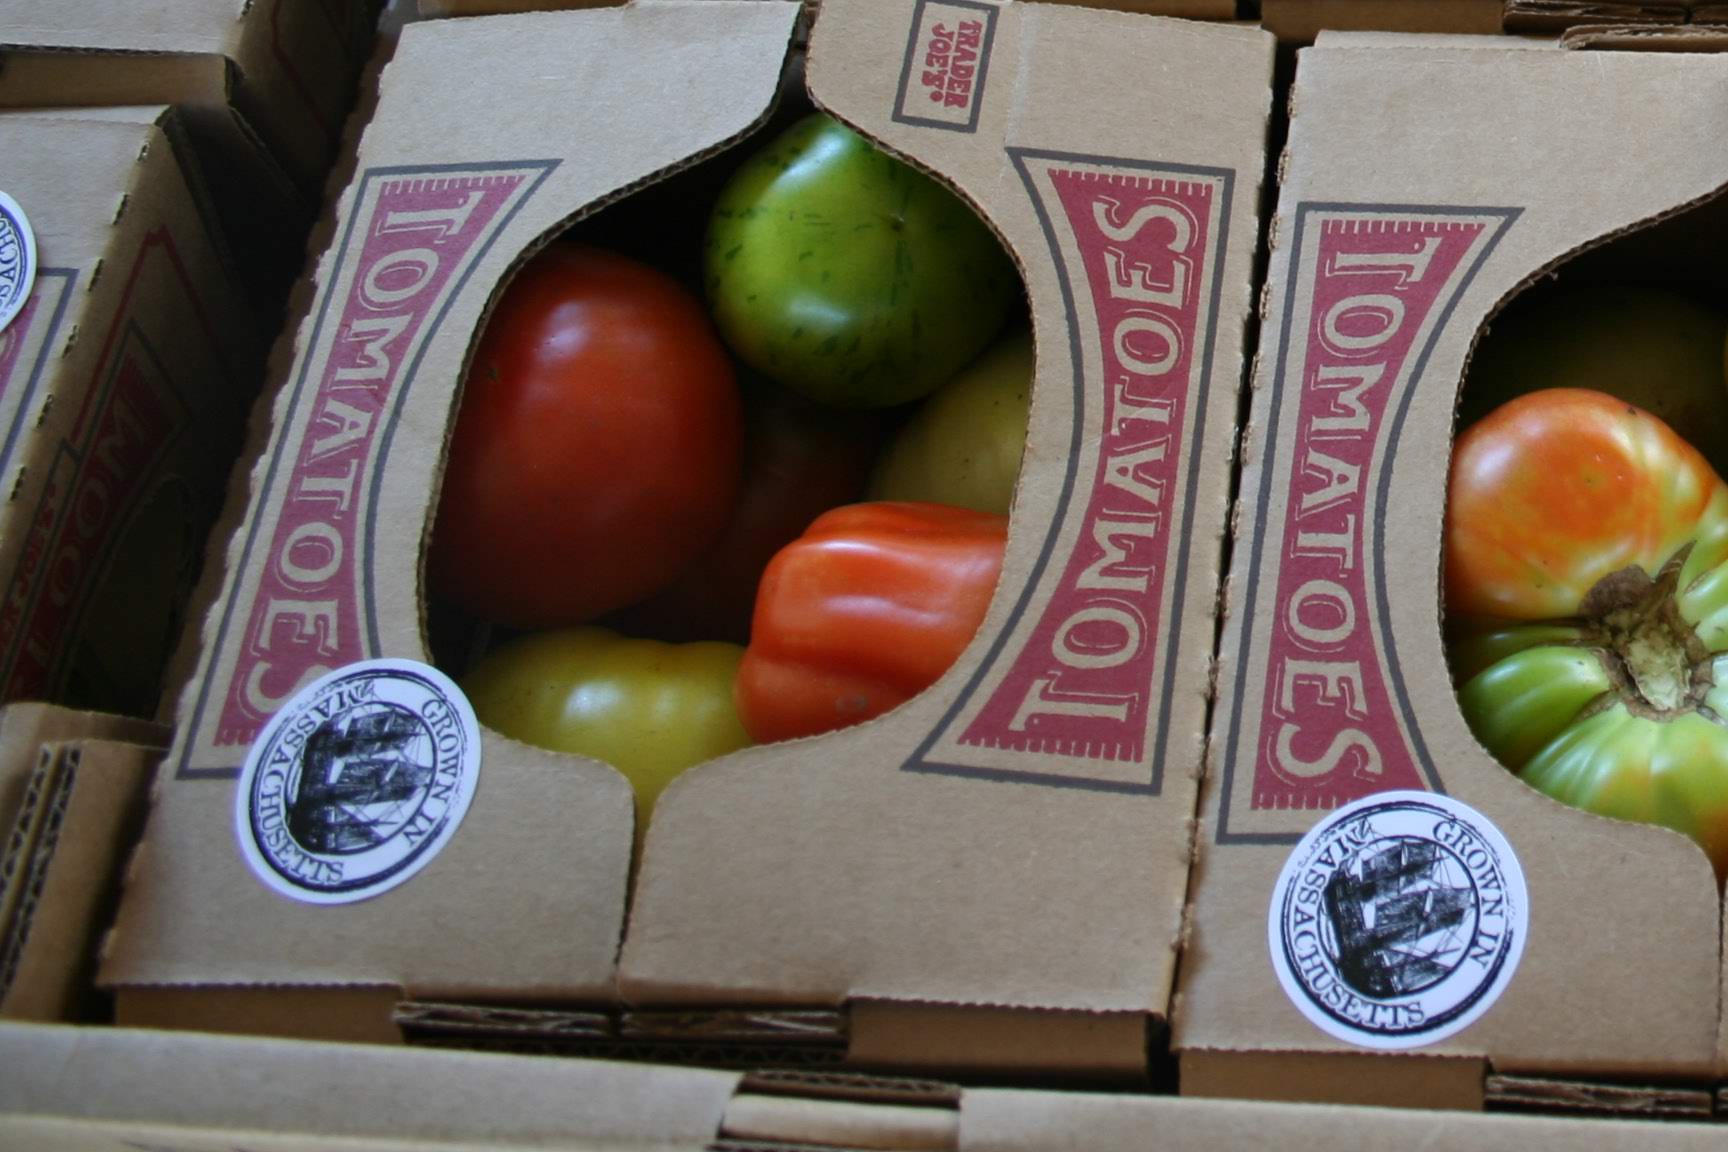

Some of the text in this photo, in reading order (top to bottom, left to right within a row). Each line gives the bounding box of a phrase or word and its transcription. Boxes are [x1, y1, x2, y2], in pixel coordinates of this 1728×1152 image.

[944, 20, 982, 108] TRADER
[1010, 195, 1199, 733] TOMATOES
[1267, 235, 1446, 786] TOMATOES
[260, 679, 375, 883] MASSACHUSETTS
[401, 698, 460, 848] GROWN IN
[1294, 816, 1425, 1027] MASSACHUSETTS
[1432, 819, 1504, 969] GROWN IN
